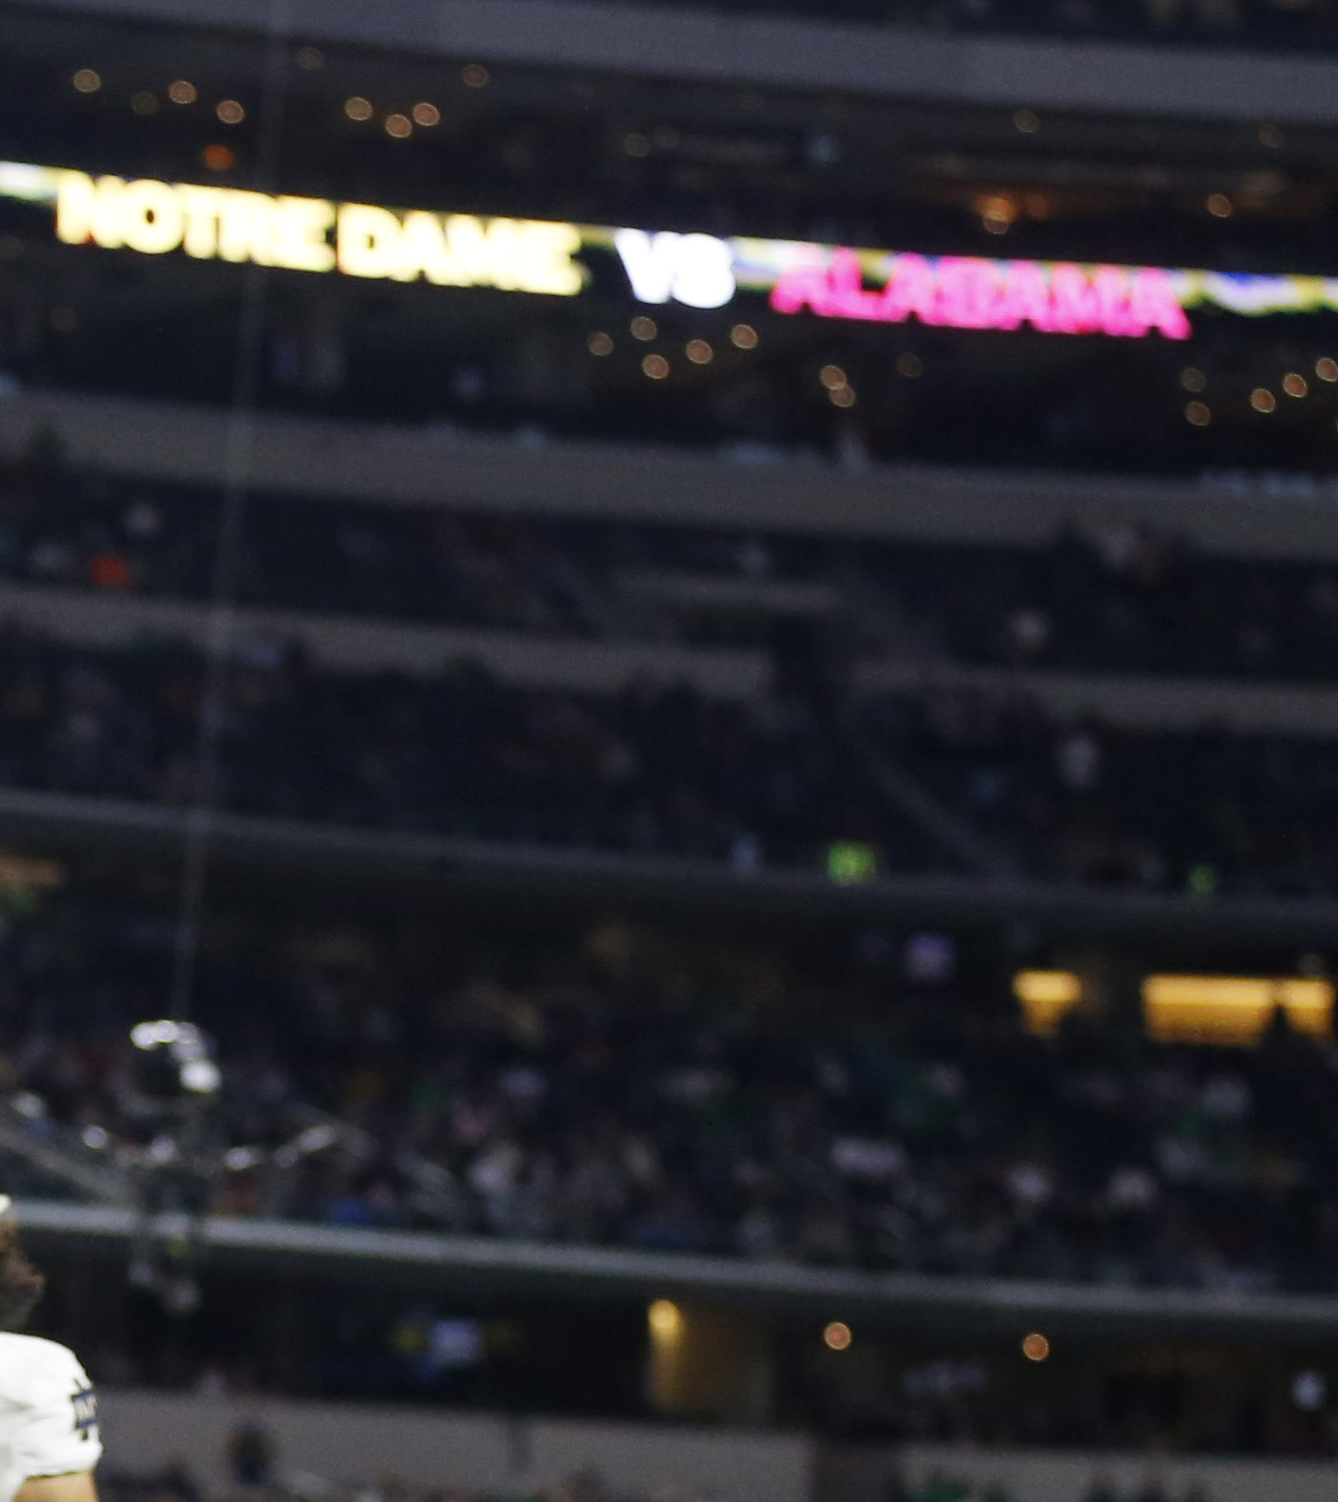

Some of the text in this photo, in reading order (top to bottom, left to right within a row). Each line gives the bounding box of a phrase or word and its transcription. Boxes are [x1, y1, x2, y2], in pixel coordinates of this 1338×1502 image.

[57, 169, 1192, 341] NOTRE DAME VS ALABAMA
